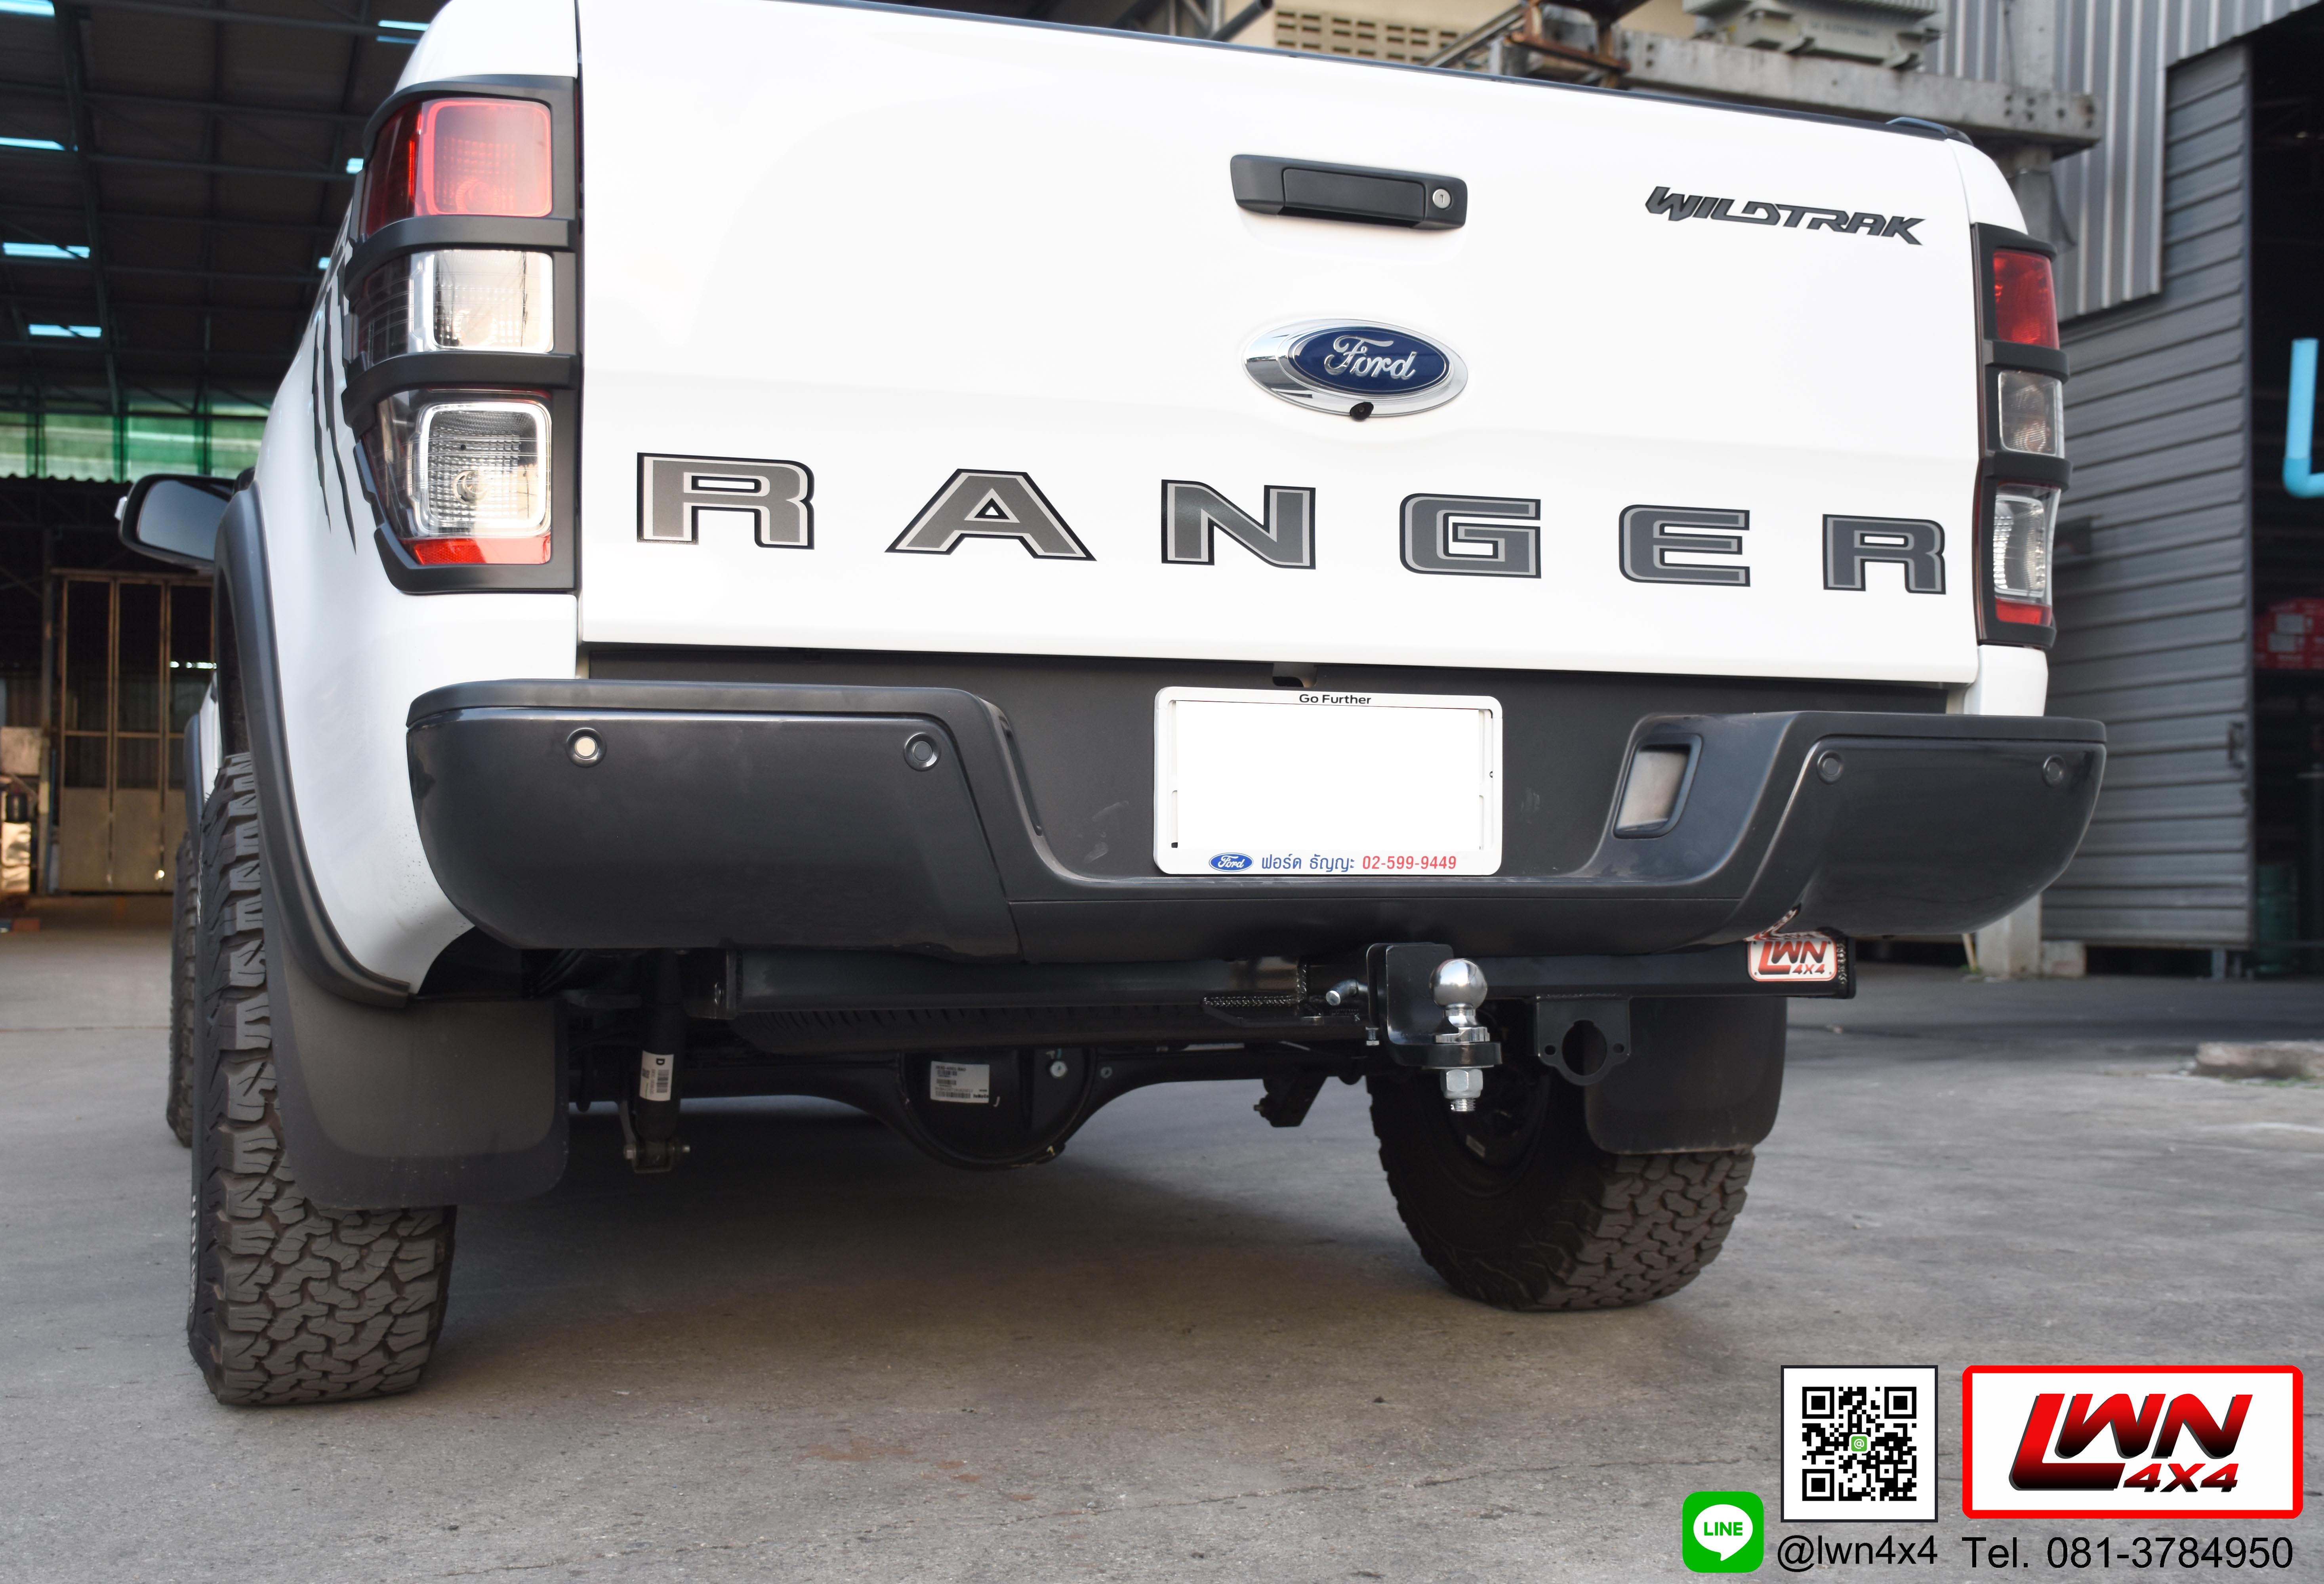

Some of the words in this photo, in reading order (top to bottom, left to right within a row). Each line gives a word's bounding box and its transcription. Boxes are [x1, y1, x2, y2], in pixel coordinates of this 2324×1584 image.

[1645, 186, 1925, 246] WILDTRAK
[1324, 335, 1417, 380] Ford
[637, 452, 1946, 595] RANGER
[1299, 694, 1319, 703] Go
[1322, 694, 1371, 704] Further
[1218, 855, 1245, 869] Ford
[1262, 853, 1302, 869] ฟอร์ด
[1310, 854, 1355, 872] ธัญญะ
[1362, 855, 1457, 870] 02-599-9449
[1758, 941, 1827, 975] LWN
